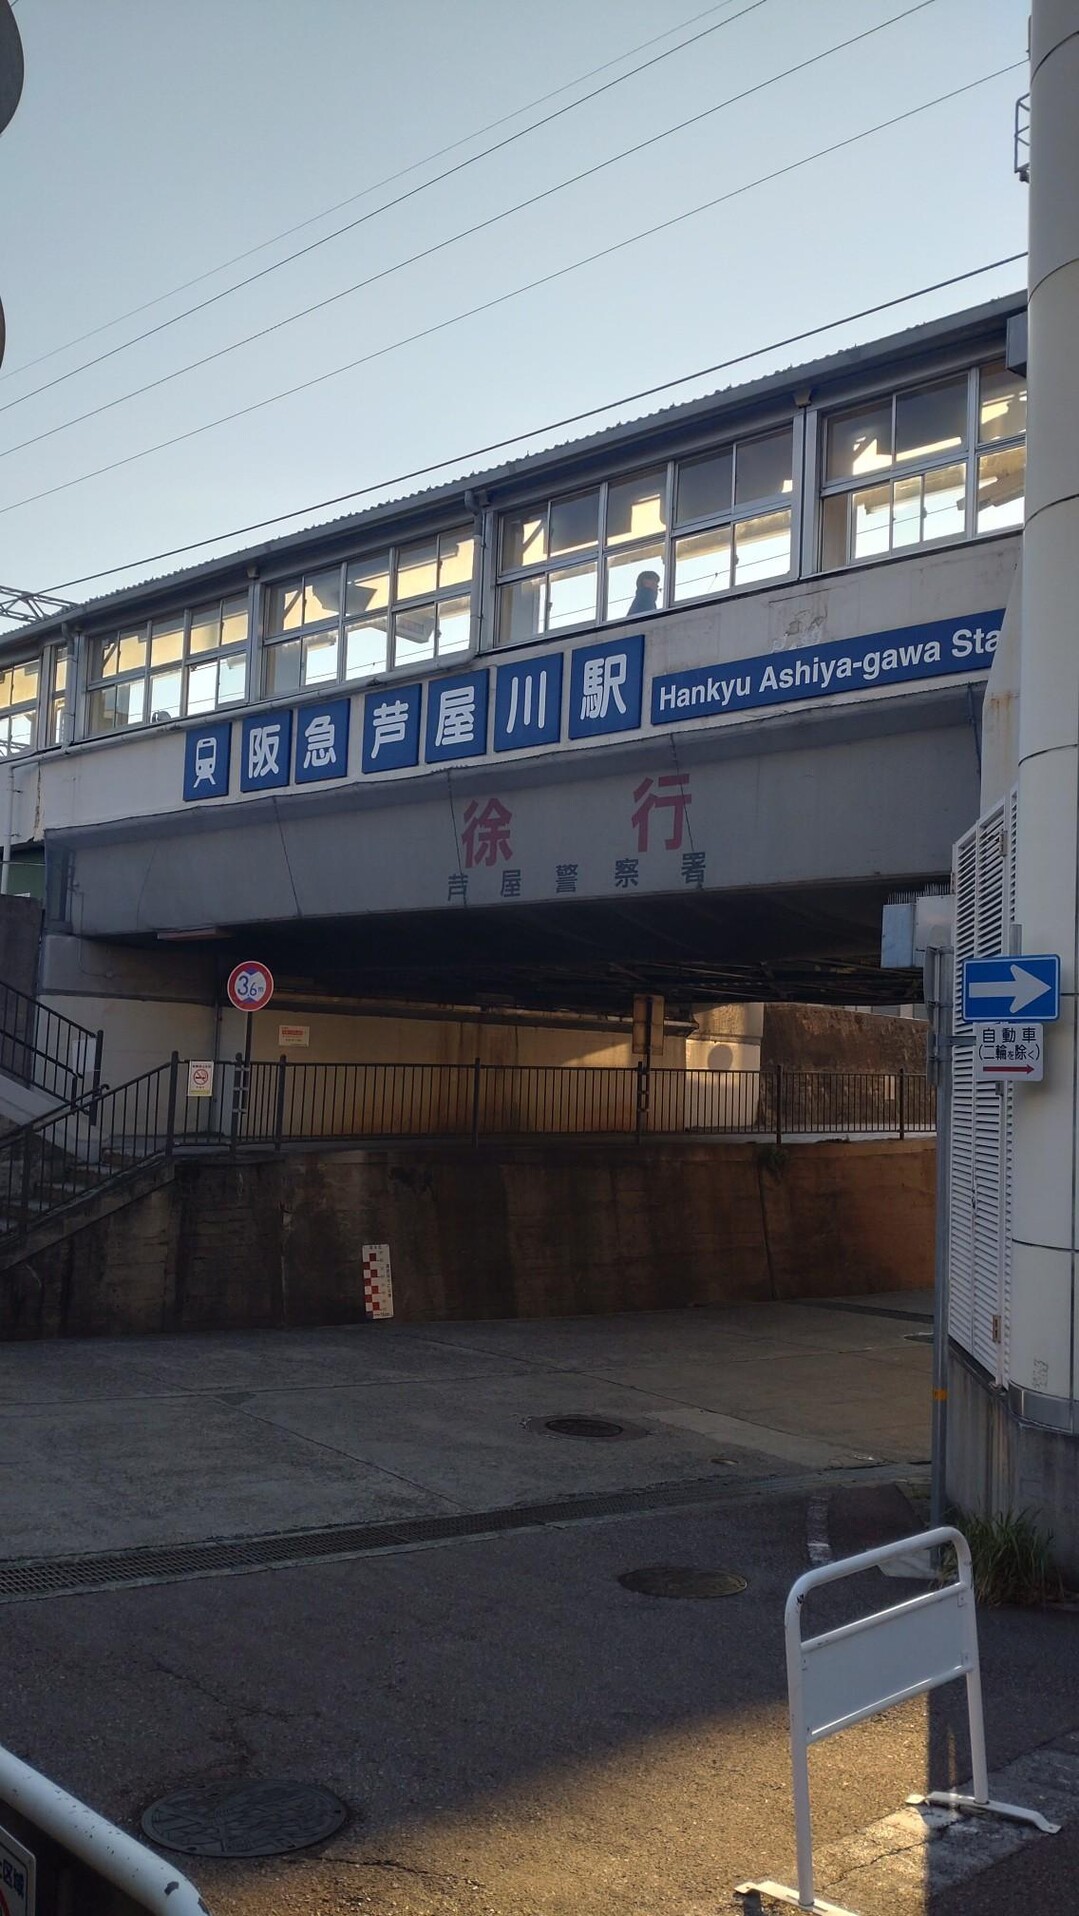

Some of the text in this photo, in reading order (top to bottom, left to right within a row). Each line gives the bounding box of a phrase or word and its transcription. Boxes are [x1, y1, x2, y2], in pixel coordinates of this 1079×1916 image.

[659, 674, 751, 711] Hankyu
[758, 641, 941, 693] Ashiya-gawa
[247, 653, 628, 780] 阪急芦屋川駅
[460, 772, 693, 869] 徐行
[447, 851, 706, 903] 芦屋警察署
[982, 1027, 1037, 1044] 自動車
